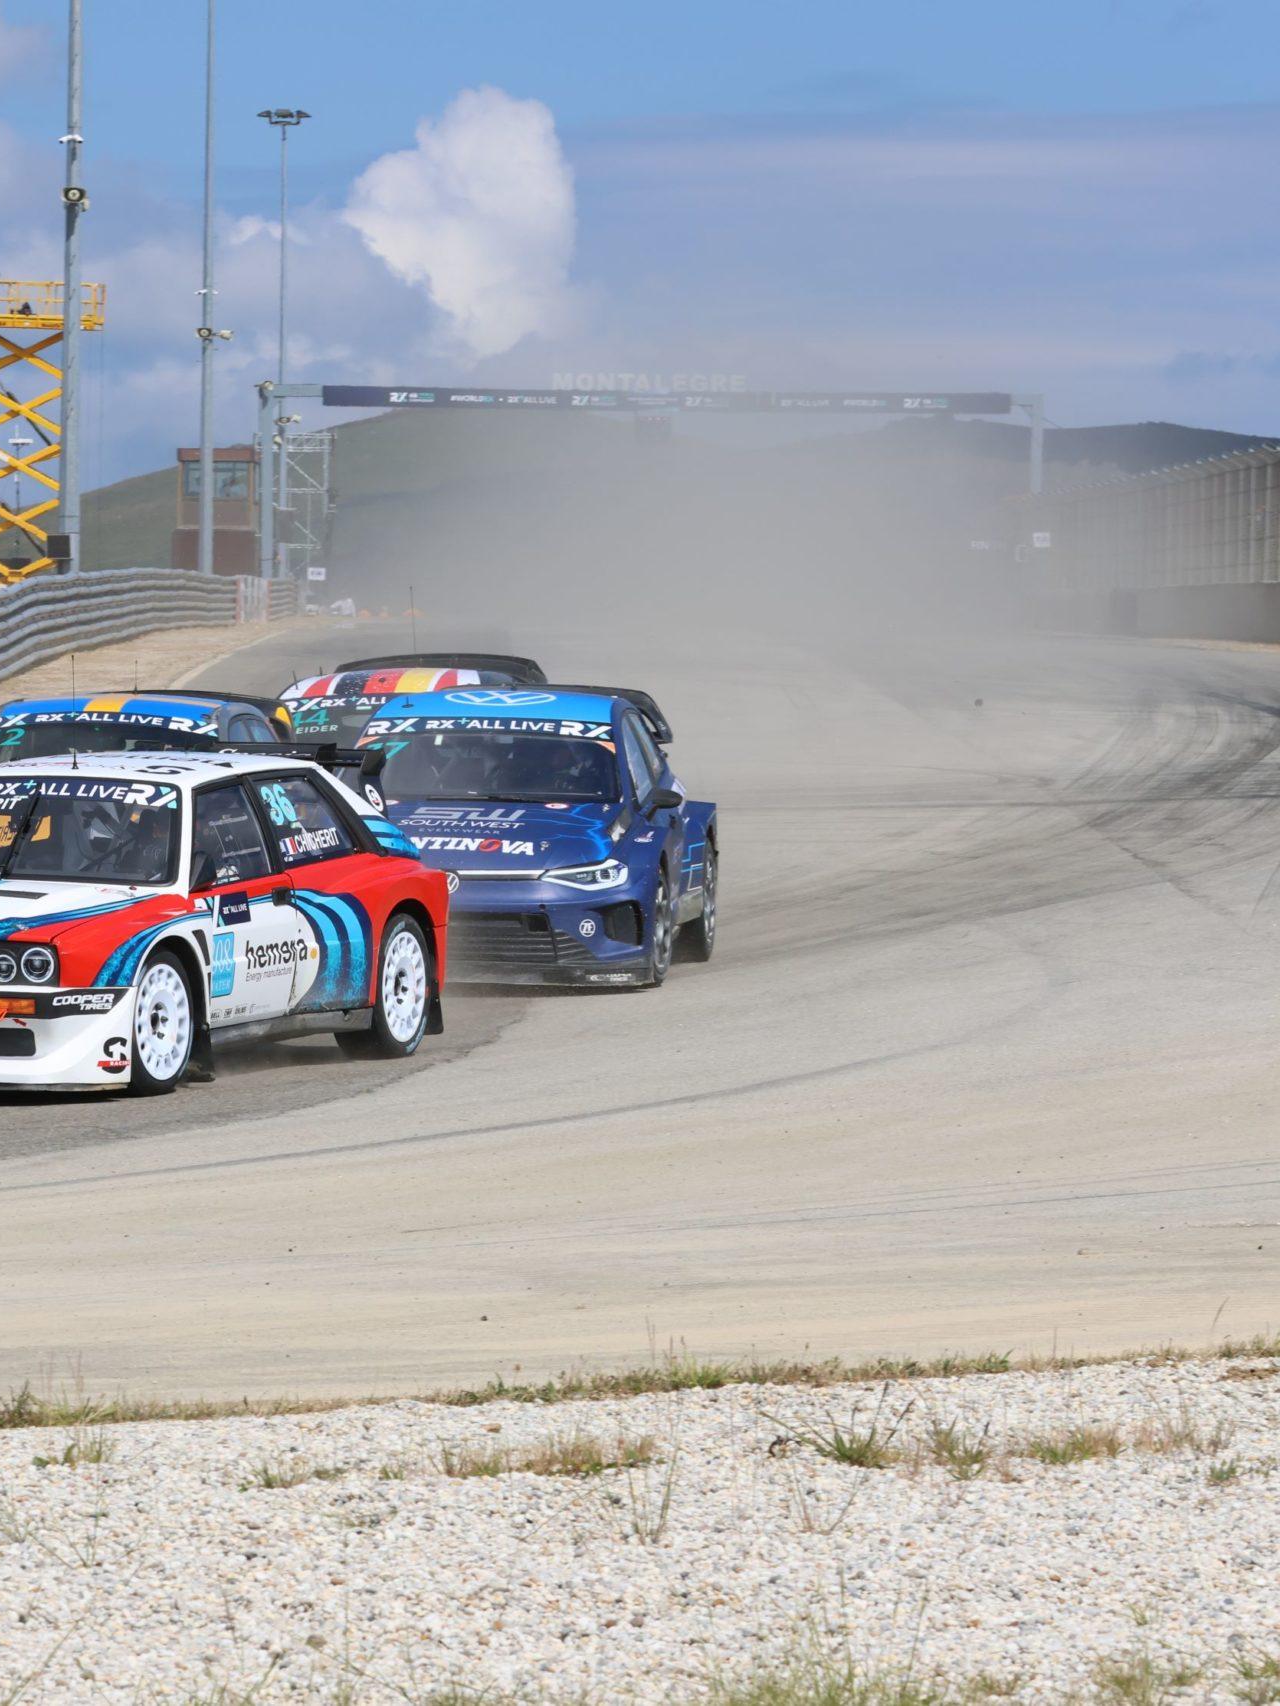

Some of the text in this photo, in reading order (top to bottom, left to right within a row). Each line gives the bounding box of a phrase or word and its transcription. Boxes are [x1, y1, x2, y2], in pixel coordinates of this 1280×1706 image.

[552, 372, 748, 393] MONTALEGRE
[122, 714, 164, 725] LIVE
[367, 717, 420, 735] RX
[510, 721, 556, 732] LIVE
[296, 725, 338, 734] EIDER
[559, 721, 613, 740] RX
[77, 783, 129, 800] LIVE
[123, 783, 177, 809] RX
[261, 784, 297, 826] 36
[295, 827, 340, 853] CHICHERIT
[409, 836, 535, 856] NTINOVA
[52, 993, 115, 1006] COOPER
[80, 1002, 113, 1011] TIRES
